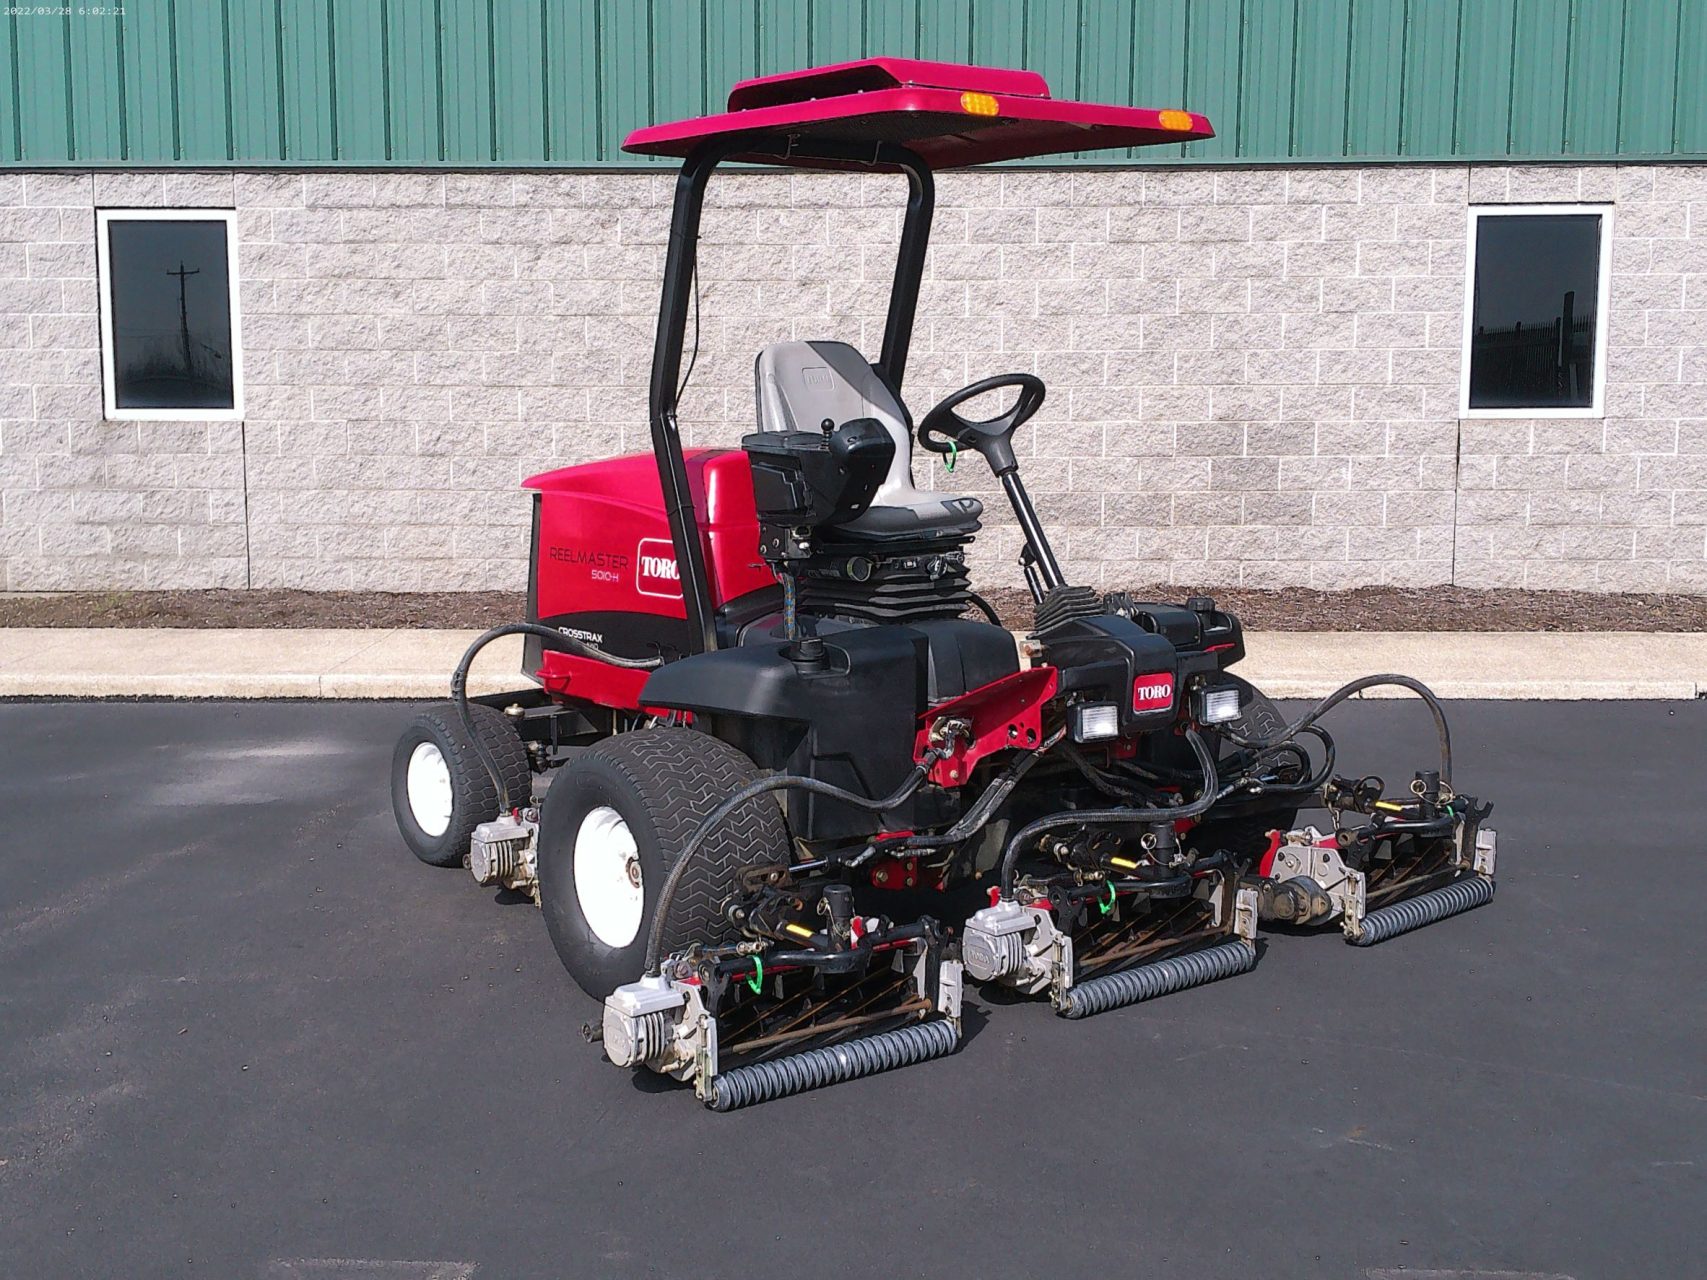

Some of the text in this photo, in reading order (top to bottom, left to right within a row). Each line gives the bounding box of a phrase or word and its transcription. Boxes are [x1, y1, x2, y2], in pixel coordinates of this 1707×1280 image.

[550, 547, 629, 569] REELMASTER
[591, 569, 619, 582] 5010-H
[558, 626, 603, 644] CROSSTRAX
[1137, 684, 1171, 701] TORO
